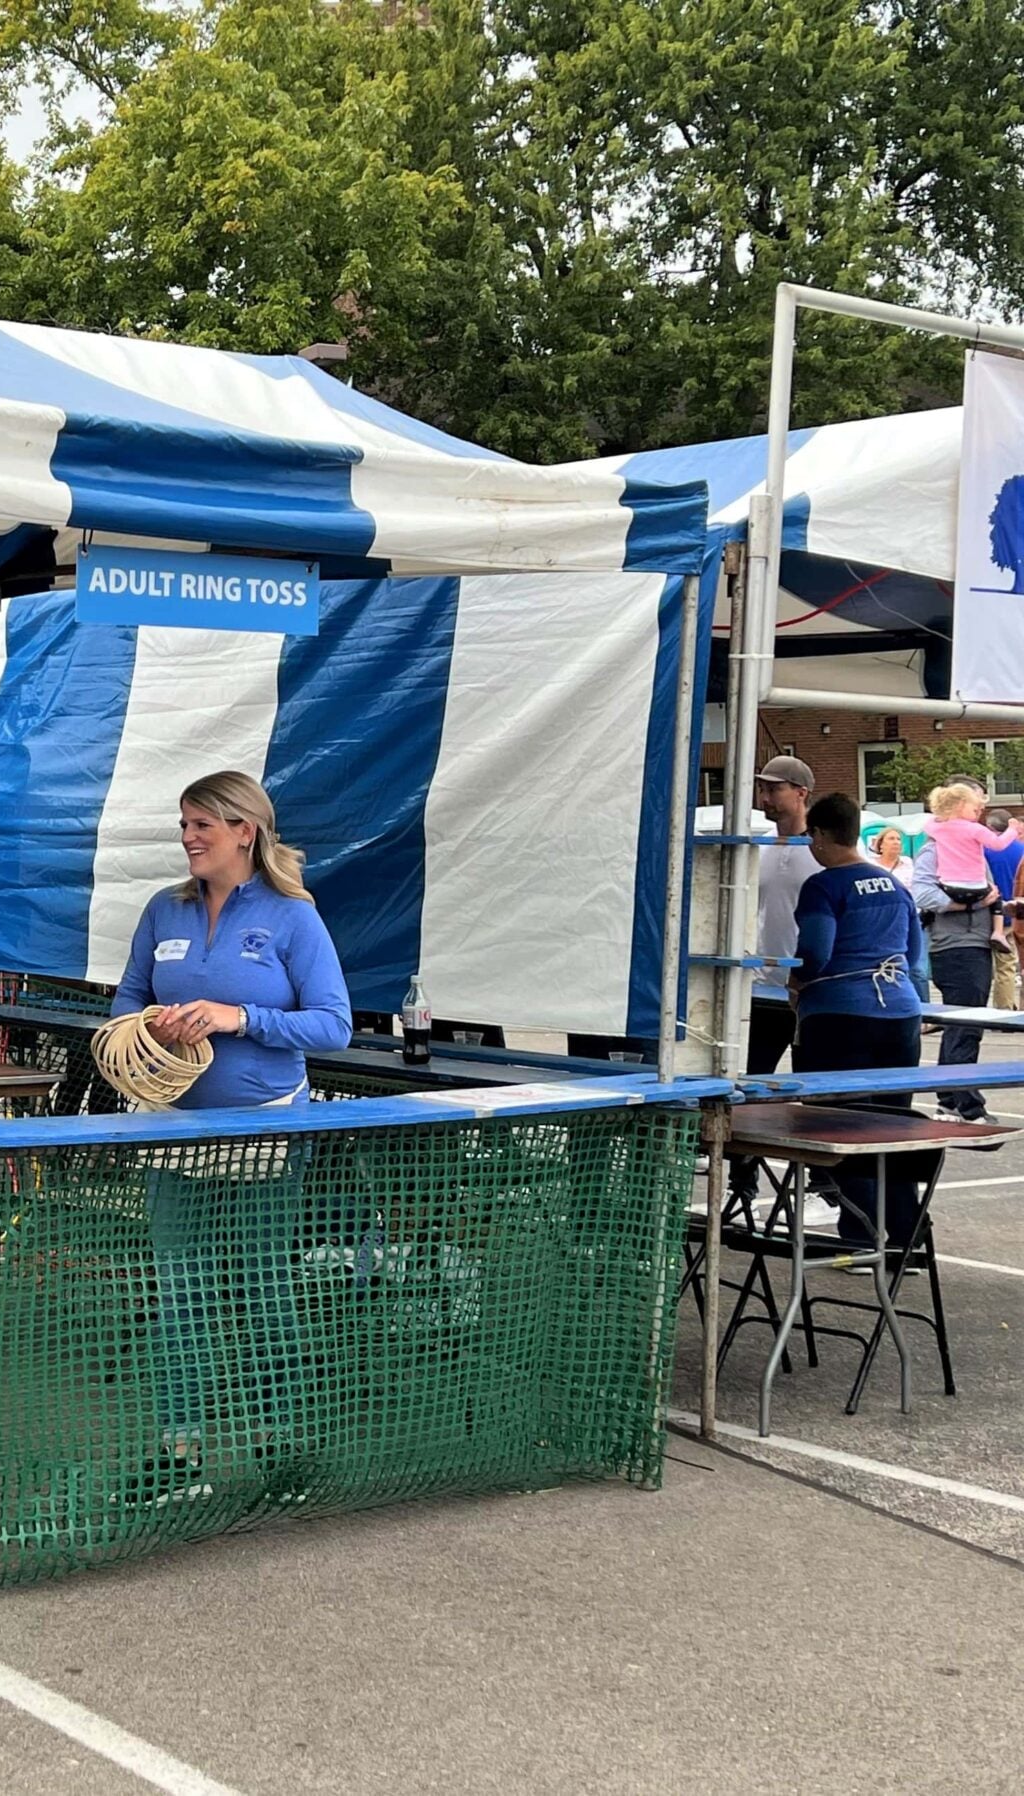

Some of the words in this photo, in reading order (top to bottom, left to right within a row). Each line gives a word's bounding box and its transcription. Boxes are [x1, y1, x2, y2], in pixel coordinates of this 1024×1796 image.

[88, 567, 175, 597] ADULT
[181, 573, 242, 602] RING
[246, 578, 307, 607] TOSS
[854, 877, 896, 895] PIEPER
